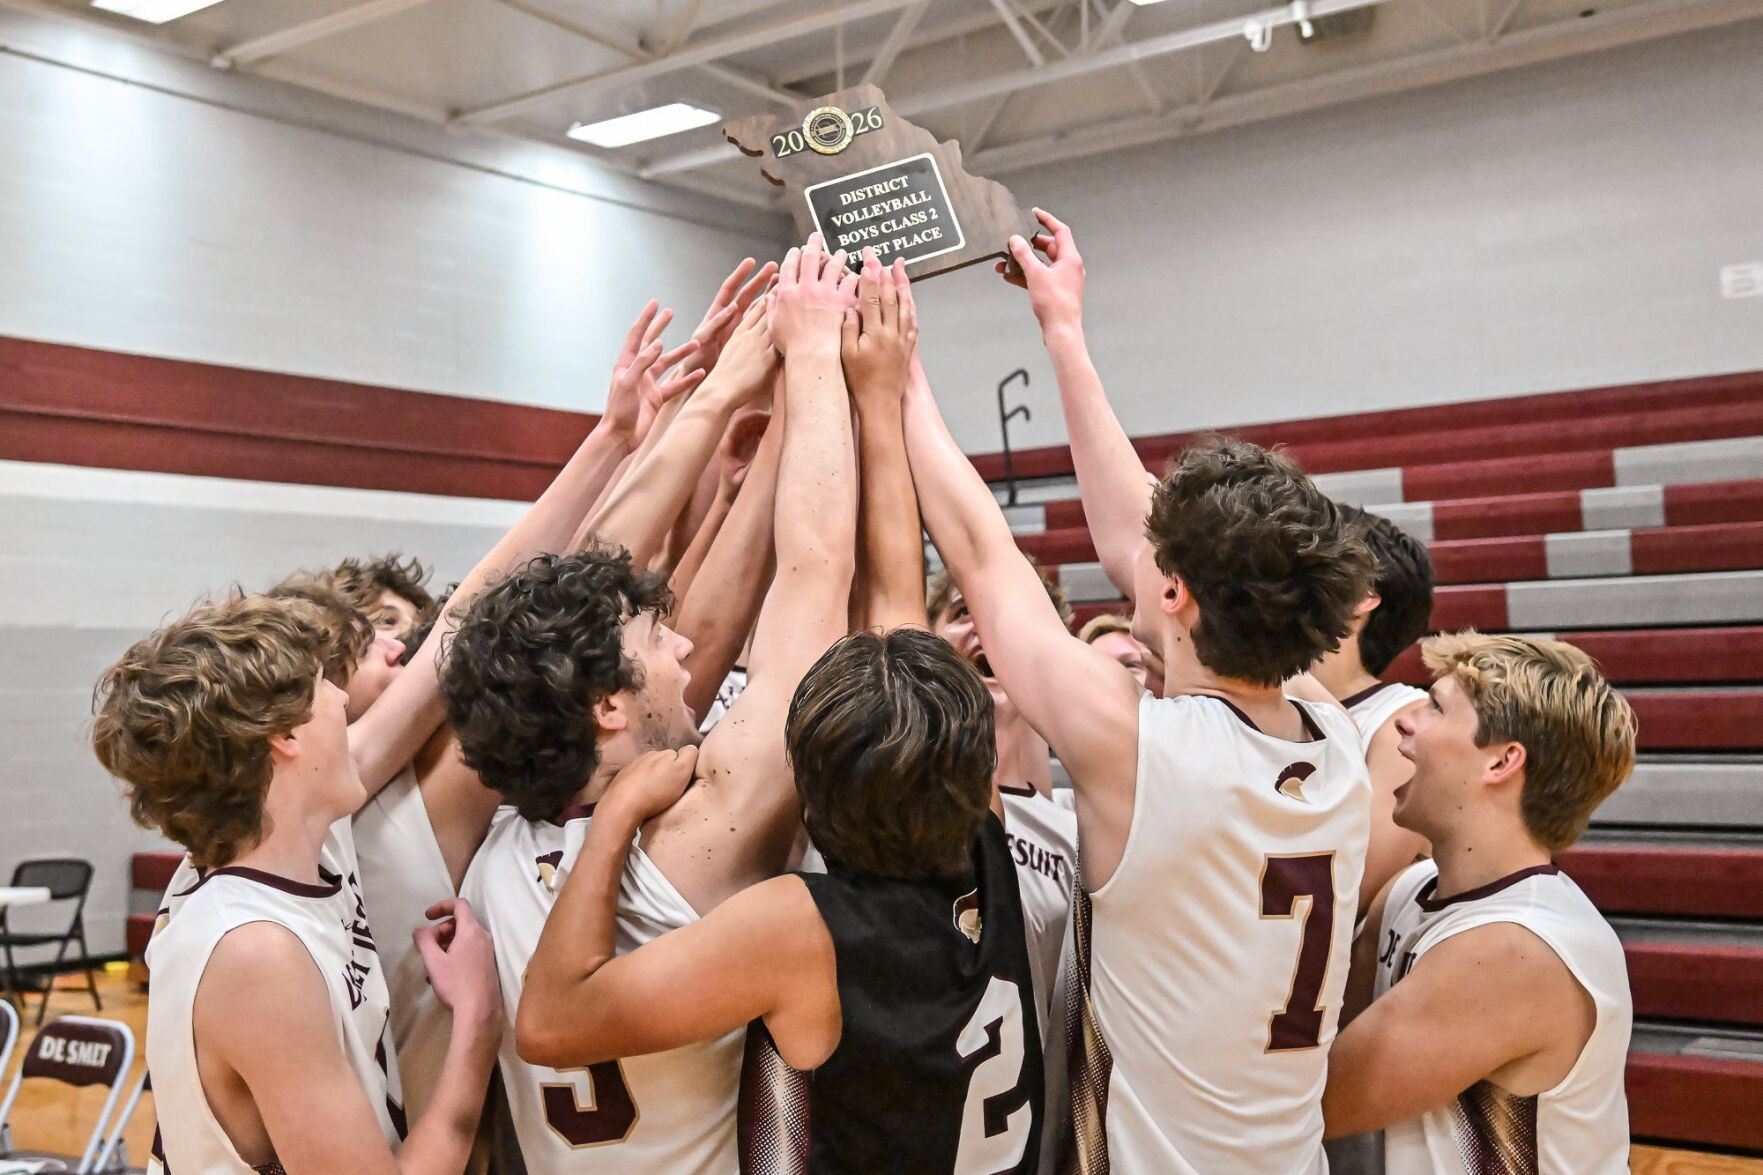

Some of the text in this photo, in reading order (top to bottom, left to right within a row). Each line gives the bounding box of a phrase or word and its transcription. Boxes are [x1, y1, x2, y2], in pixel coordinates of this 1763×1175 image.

[773, 131, 804, 157] 20
[851, 107, 882, 134] 26
[831, 190, 932, 227] VOLLEYBALL
[840, 175, 909, 205] DISTRICT
[838, 207, 939, 246] BOYS CLASS 2
[848, 226, 943, 264] FIST PLACE
[1259, 850, 1336, 1054] 7
[38, 1036, 112, 1067] DE SMET
[953, 975, 1033, 1175] 2
